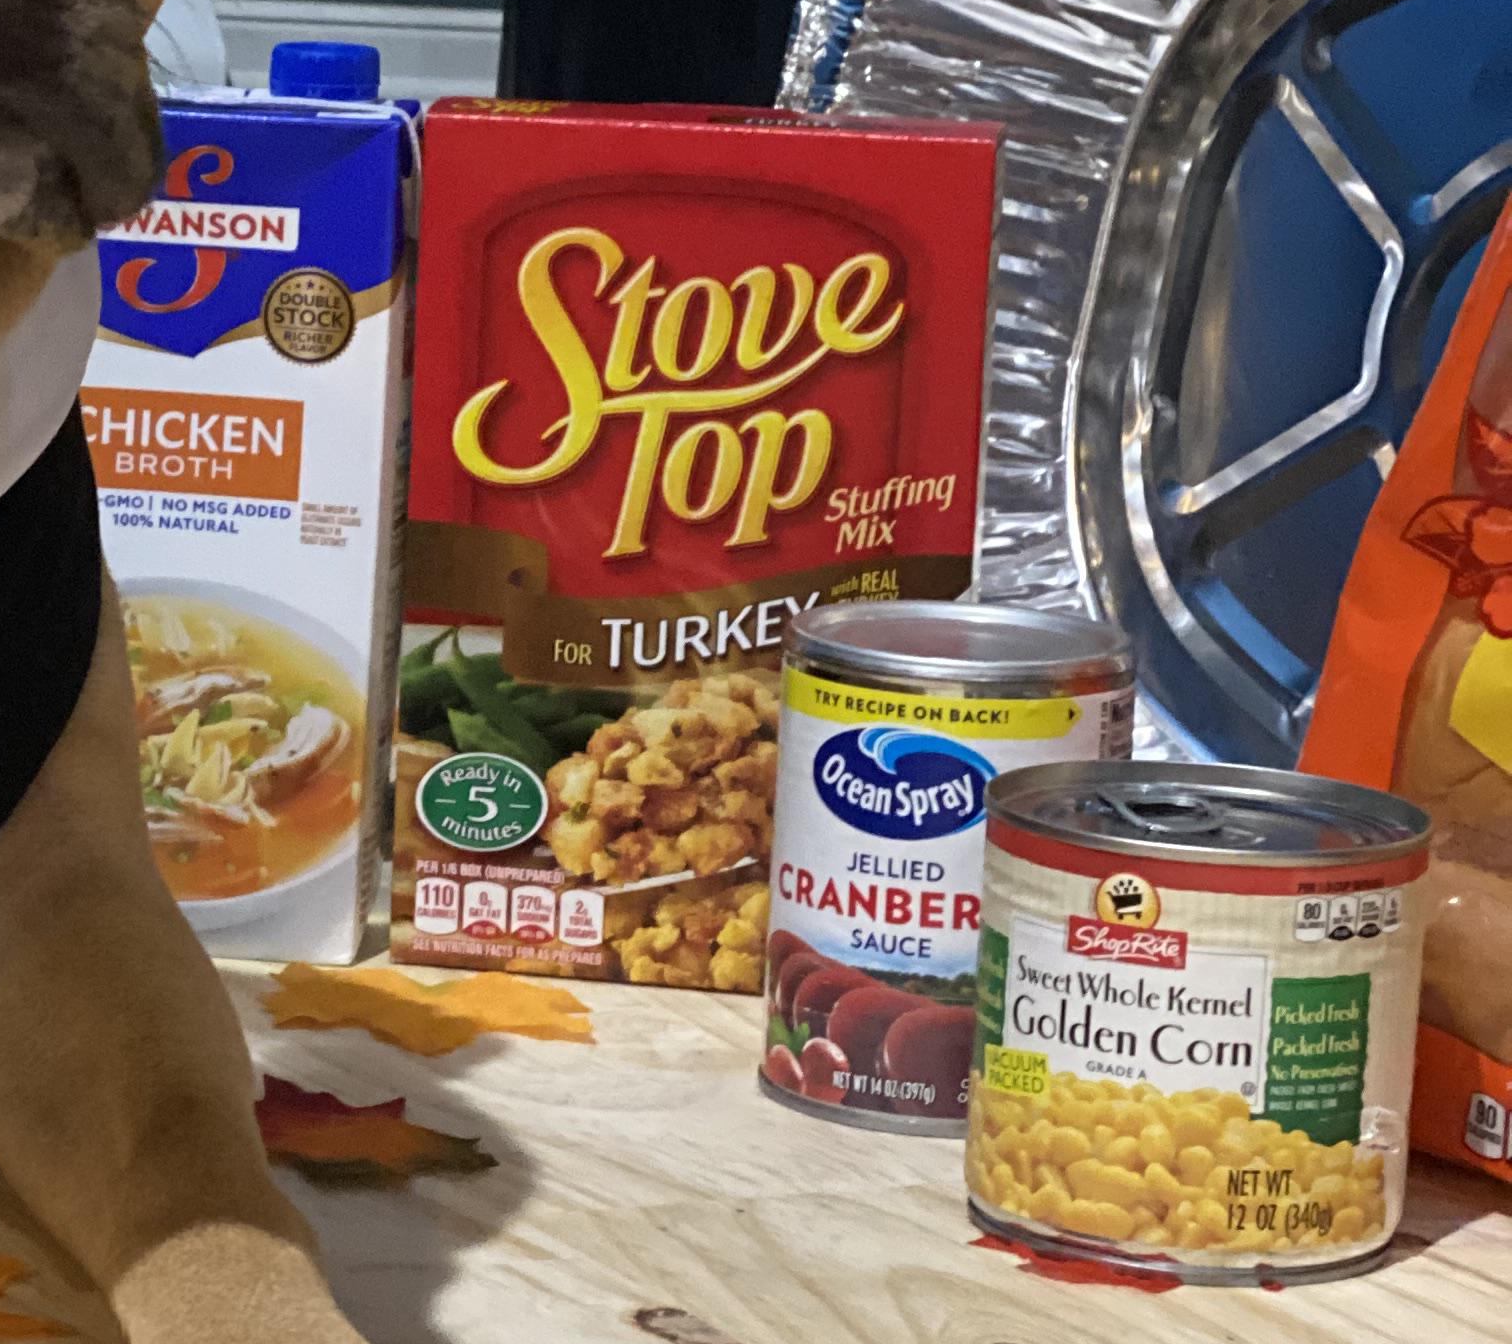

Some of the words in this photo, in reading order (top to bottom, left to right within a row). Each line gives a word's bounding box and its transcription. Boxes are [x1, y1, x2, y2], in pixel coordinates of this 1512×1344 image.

[280, 292, 340, 309] DOUBLE
[274, 306, 345, 329] STOCK
[284, 331, 333, 345] RICHER
[453, 227, 905, 484] Stove
[80, 404, 284, 457] CHICKEN
[115, 451, 233, 480] BROTH
[548, 388, 832, 560] Top
[98, 494, 144, 509] -GMO
[162, 498, 188, 512] NO
[192, 499, 228, 515] MSG
[232, 503, 291, 520] ADDED
[824, 474, 956, 523] Stuffing
[113, 513, 154, 529] 100%
[159, 516, 239, 534] NATURAL
[835, 515, 896, 554] Mix
[831, 576, 858, 597] with
[861, 568, 899, 594] REAL
[555, 638, 592, 665] FOR
[601, 591, 820, 670] TURKEY
[815, 689, 840, 706] TRY
[845, 696, 907, 718] RECIPE
[914, 706, 942, 721] ON
[950, 708, 1009, 724] BACK!
[440, 762, 500, 787] Ready
[503, 769, 523, 793] in
[822, 753, 892, 816] Ocean
[894, 772, 975, 826] Spray
[467, 785, 498, 822] 5
[441, 816, 522, 841] minutes
[416, 860, 438, 874] PER
[442, 863, 457, 875] 1/6
[460, 864, 482, 878] BOX
[485, 864, 565, 884] (UNPREPARED)
[847, 852, 945, 882] JELLIED
[421, 884, 454, 907] 110
[778, 863, 981, 931] CRANBER
[1304, 903, 1321, 920] 80
[850, 928, 933, 958] SAUCE
[1071, 925, 1181, 961] ShopRite
[1017, 954, 1071, 994] Sweet
[1077, 971, 1161, 1010] Whole
[1168, 986, 1253, 1018] Kernel
[1274, 1002, 1326, 1024] Picked
[1012, 994, 1137, 1058] Golden
[1150, 1023, 1253, 1067] Corn
[1273, 1033, 1327, 1056] Packed
[989, 1068, 1045, 1094] PACKED
[1086, 1059, 1134, 1078] GRADE
[1138, 1069, 1148, 1080] A
[833, 1070, 852, 1089] NET
[853, 1074, 868, 1093] WT
[870, 1076, 882, 1096] 14
[884, 1079, 898, 1098] OZ
[899, 1081, 937, 1105] (397g)
[1476, 1099, 1497, 1129] 90
[1227, 1169, 1260, 1196] NET
[1265, 1169, 1293, 1196] WT
[1228, 1203, 1246, 1230] 12
[1256, 1204, 1277, 1230] OZ
[1284, 1201, 1333, 1238] (340g)
